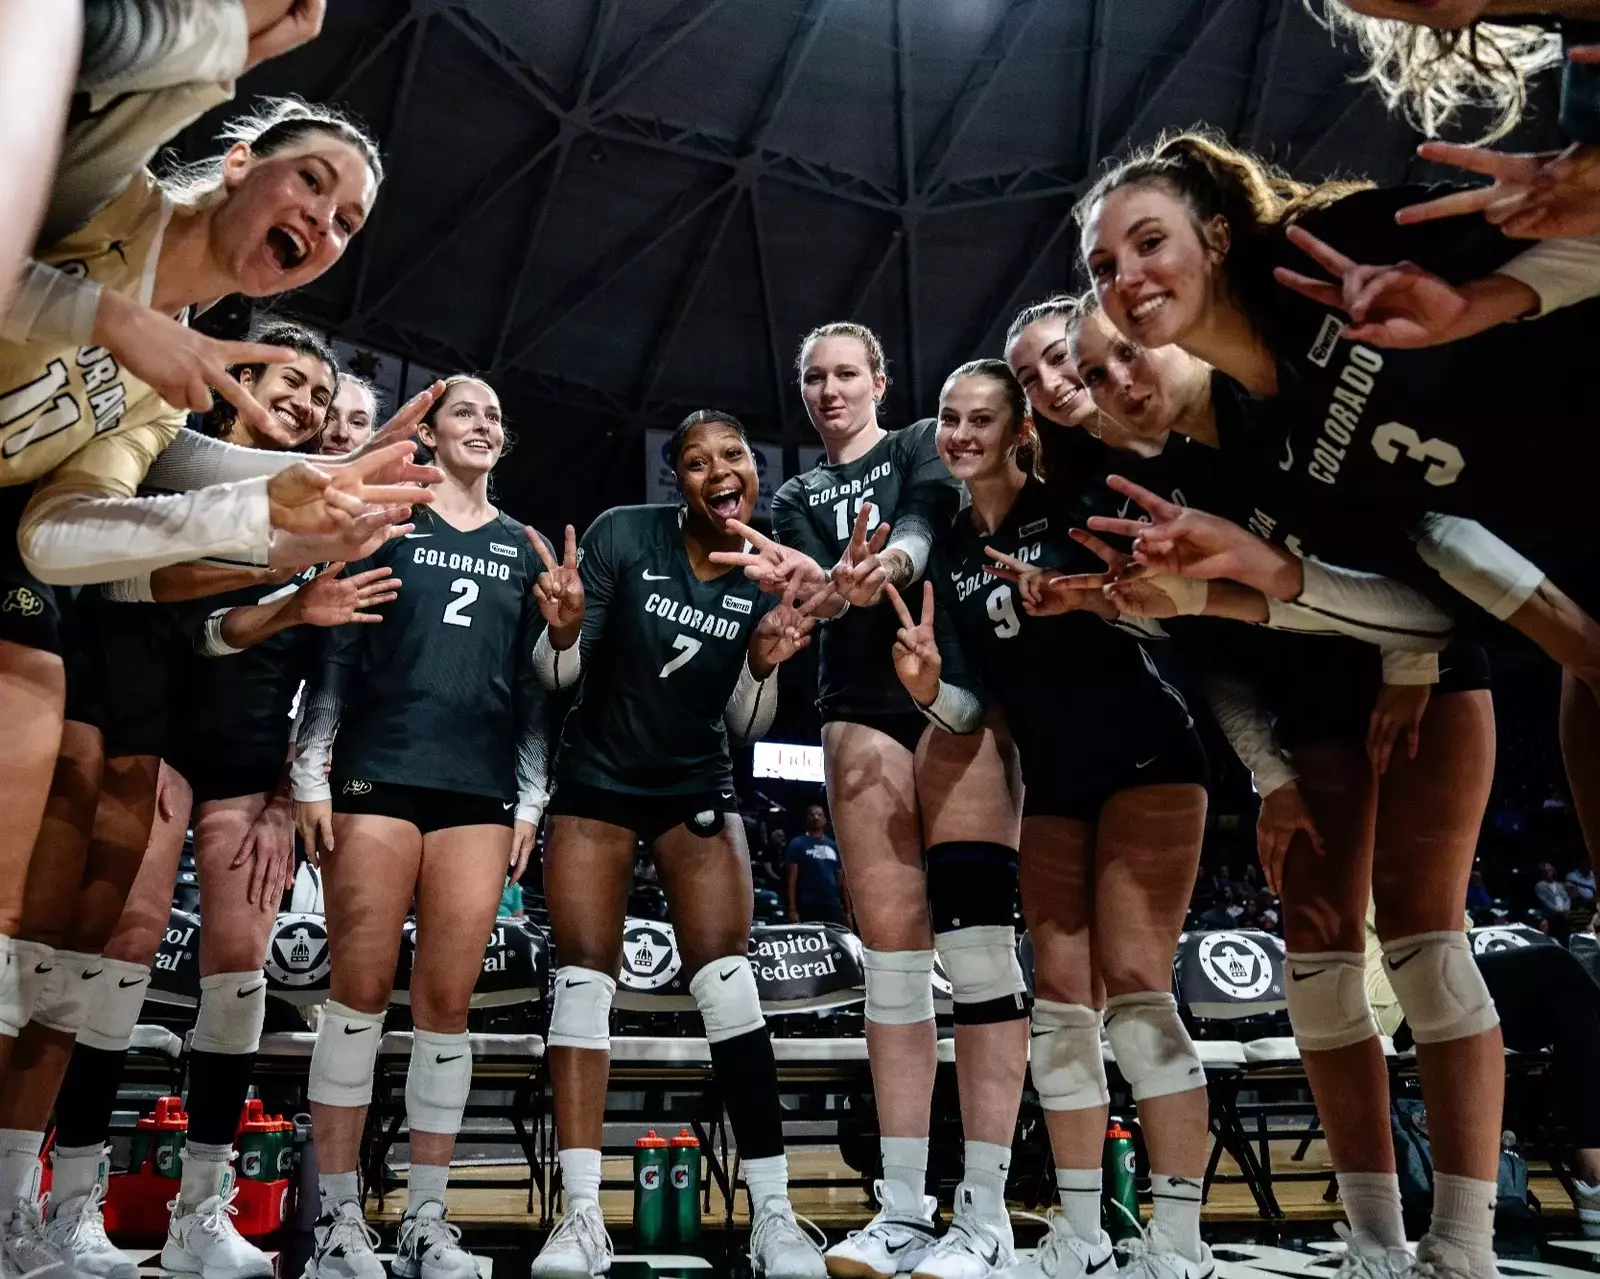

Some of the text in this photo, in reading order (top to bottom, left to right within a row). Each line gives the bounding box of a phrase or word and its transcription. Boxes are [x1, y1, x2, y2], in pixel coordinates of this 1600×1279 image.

[1308, 344, 1385, 484] COLORADO
[1371, 421, 1466, 487] 3
[809, 461, 891, 507] COLORADO
[833, 487, 881, 541] 15
[413, 547, 510, 580] COLORADO
[443, 578, 480, 627] 2
[645, 593, 741, 640] COLORADO
[986, 584, 1021, 639] 9
[659, 633, 703, 678] 7
[241, 1151, 262, 1177] G
[639, 1165, 660, 1191] G
[670, 1164, 689, 1190] G
